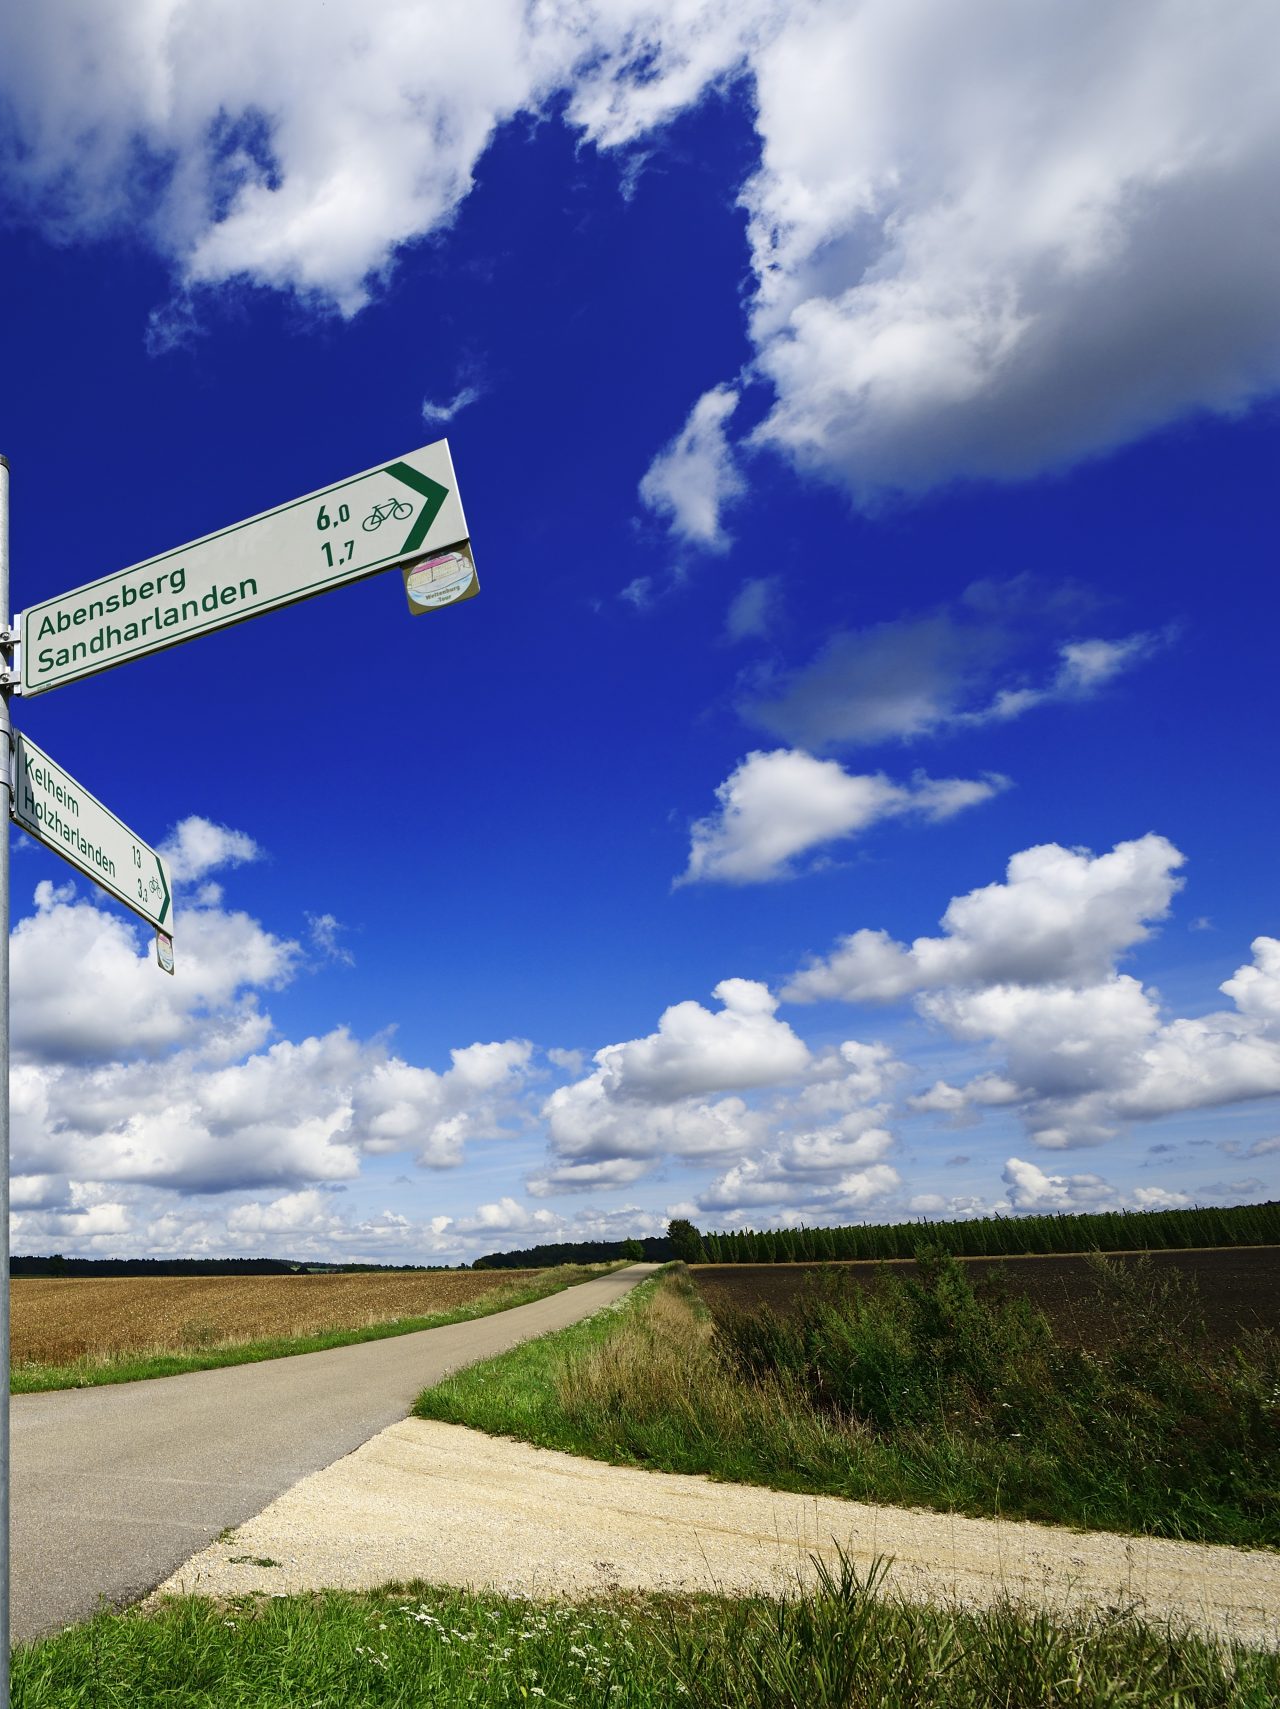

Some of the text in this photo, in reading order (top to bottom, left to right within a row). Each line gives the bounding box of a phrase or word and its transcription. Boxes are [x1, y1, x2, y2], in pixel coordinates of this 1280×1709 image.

[316, 503, 351, 531] 6,0
[321, 539, 355, 568] 1,7
[36, 567, 187, 641] Abensberg
[36, 576, 259, 673] Sandharlanden
[24, 752, 79, 817] Kelheim
[24, 786, 116, 878] Holzharlanden
[132, 845, 142, 869] 13
